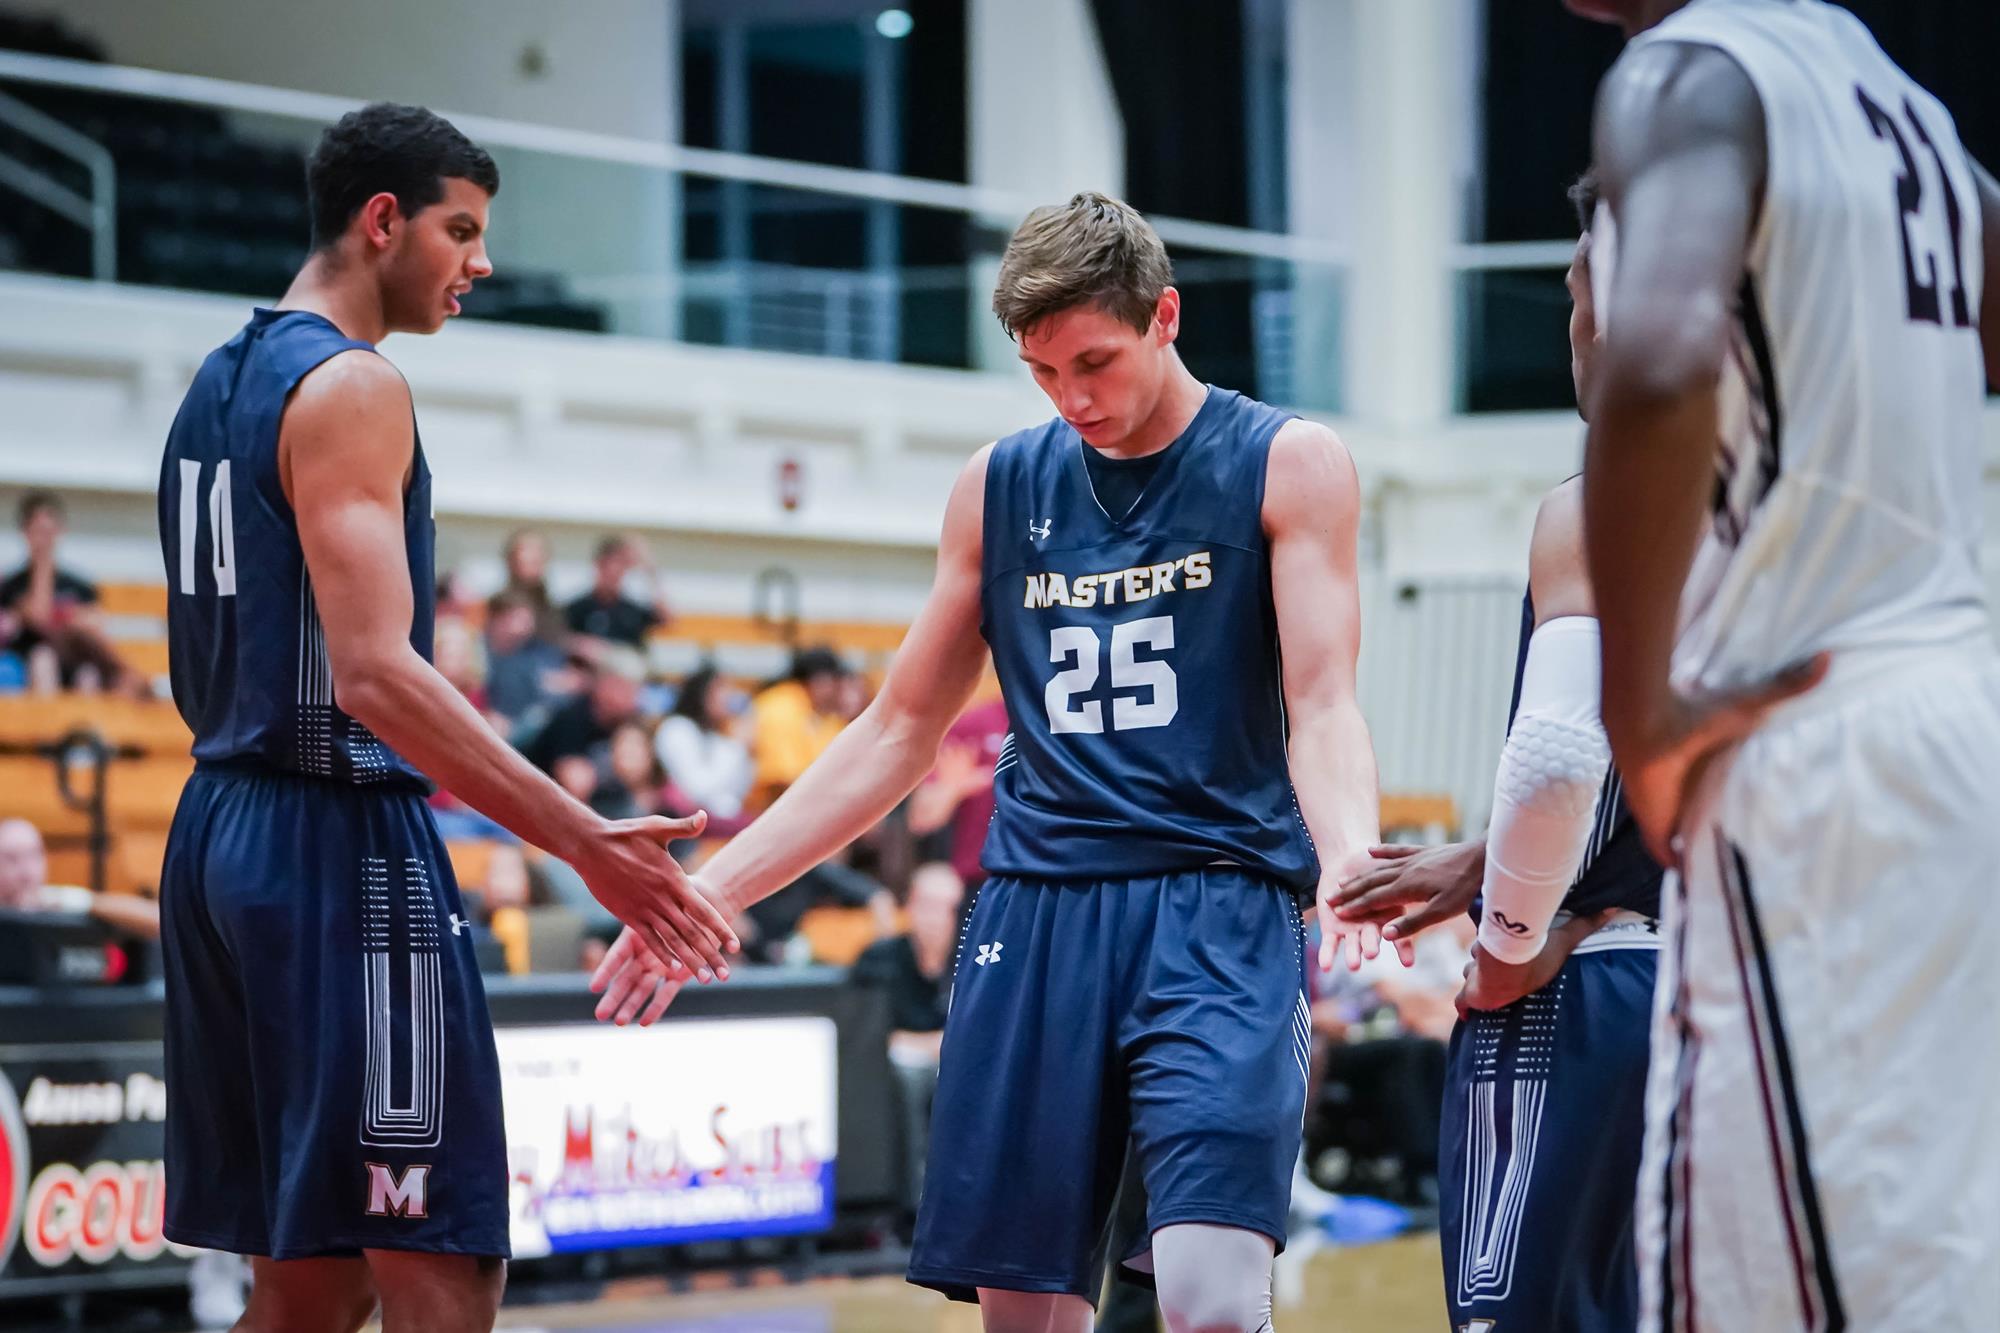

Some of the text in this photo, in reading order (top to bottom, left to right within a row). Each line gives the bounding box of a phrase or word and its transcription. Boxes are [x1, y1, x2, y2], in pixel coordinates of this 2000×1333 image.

[1855, 82, 1971, 328] 21
[1023, 551, 1212, 609] MASTER'S
[1044, 615, 1179, 735] 25
[24, 1160, 166, 1268] COU
[365, 1162, 432, 1218] M
